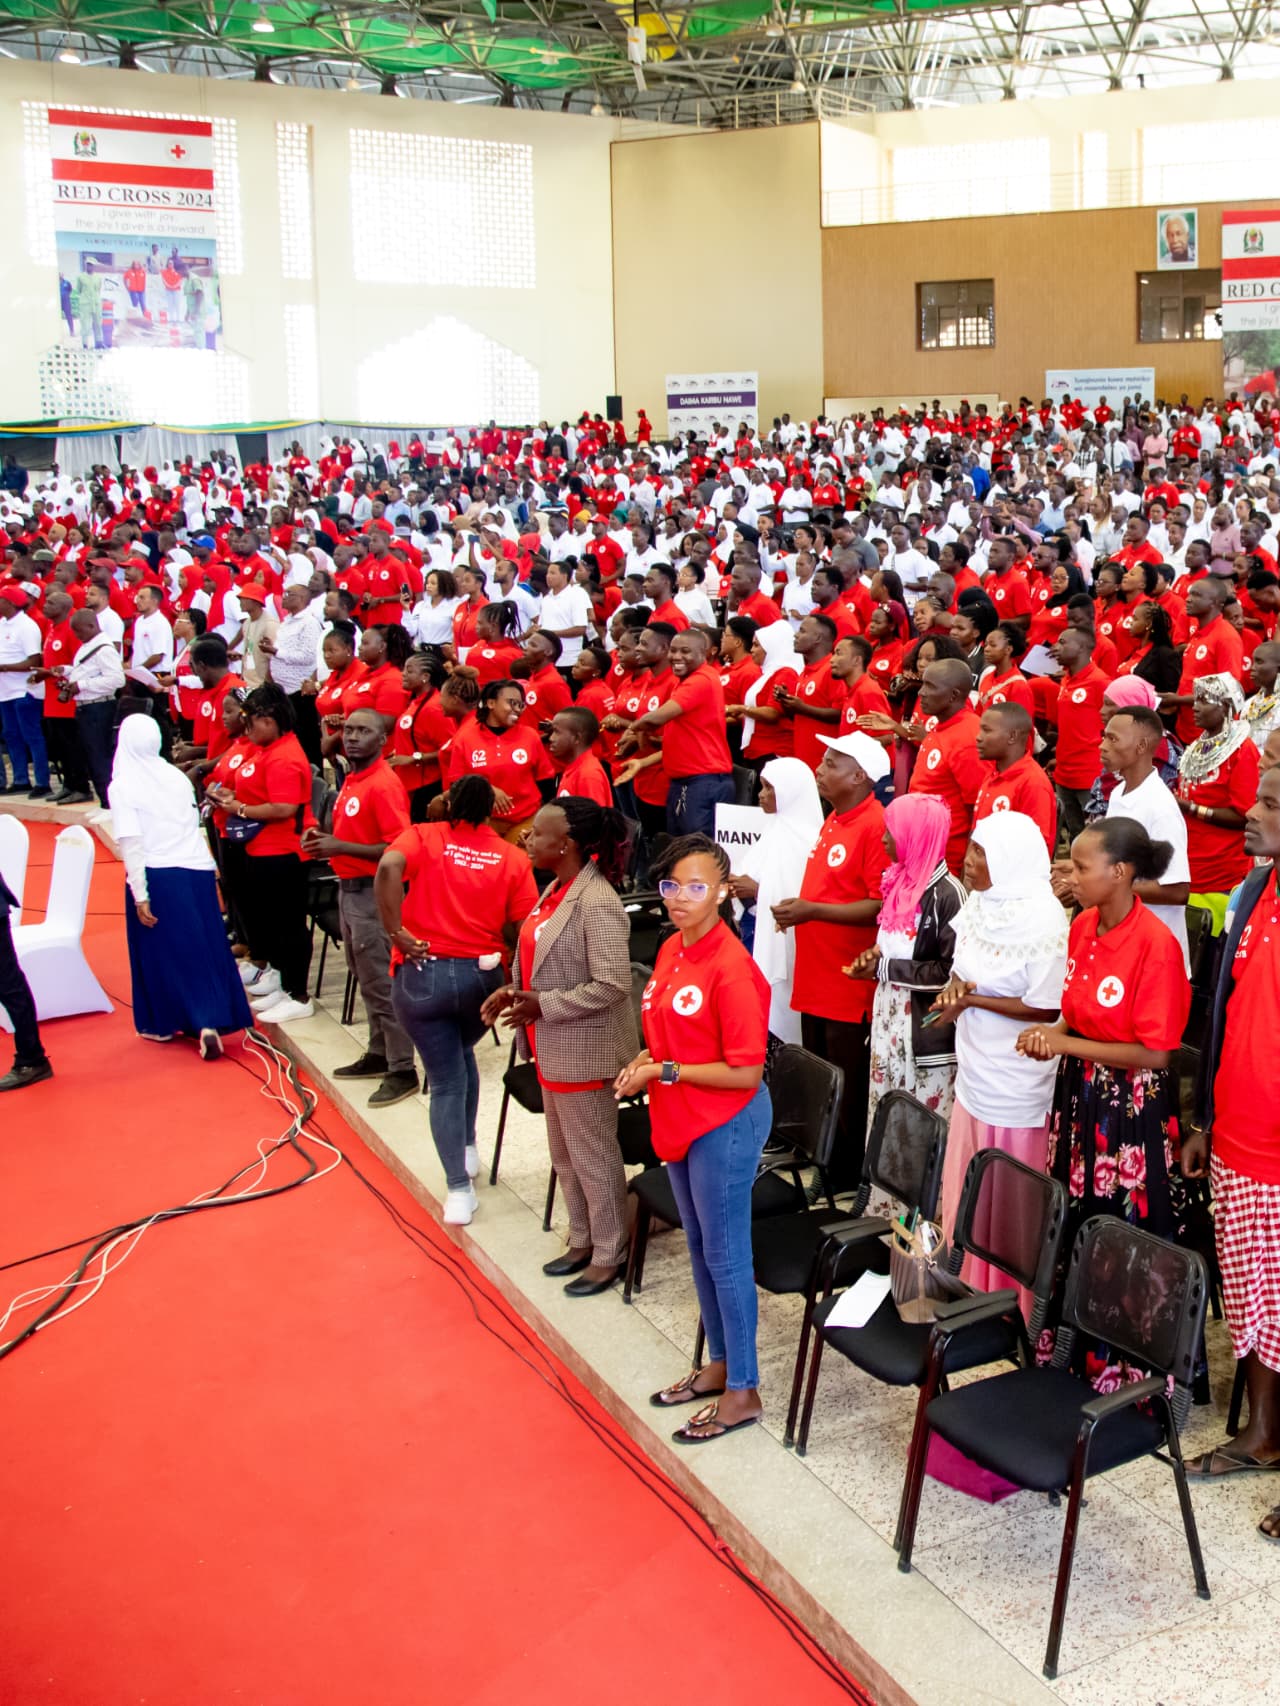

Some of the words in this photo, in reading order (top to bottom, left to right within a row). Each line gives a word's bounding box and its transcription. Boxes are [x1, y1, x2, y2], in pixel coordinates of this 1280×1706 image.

[57, 184, 101, 200] RED
[108, 187, 171, 204] CROSS
[176, 192, 213, 207] 2024
[1227, 283, 1265, 298] RED
[471, 749, 486, 762] 62
